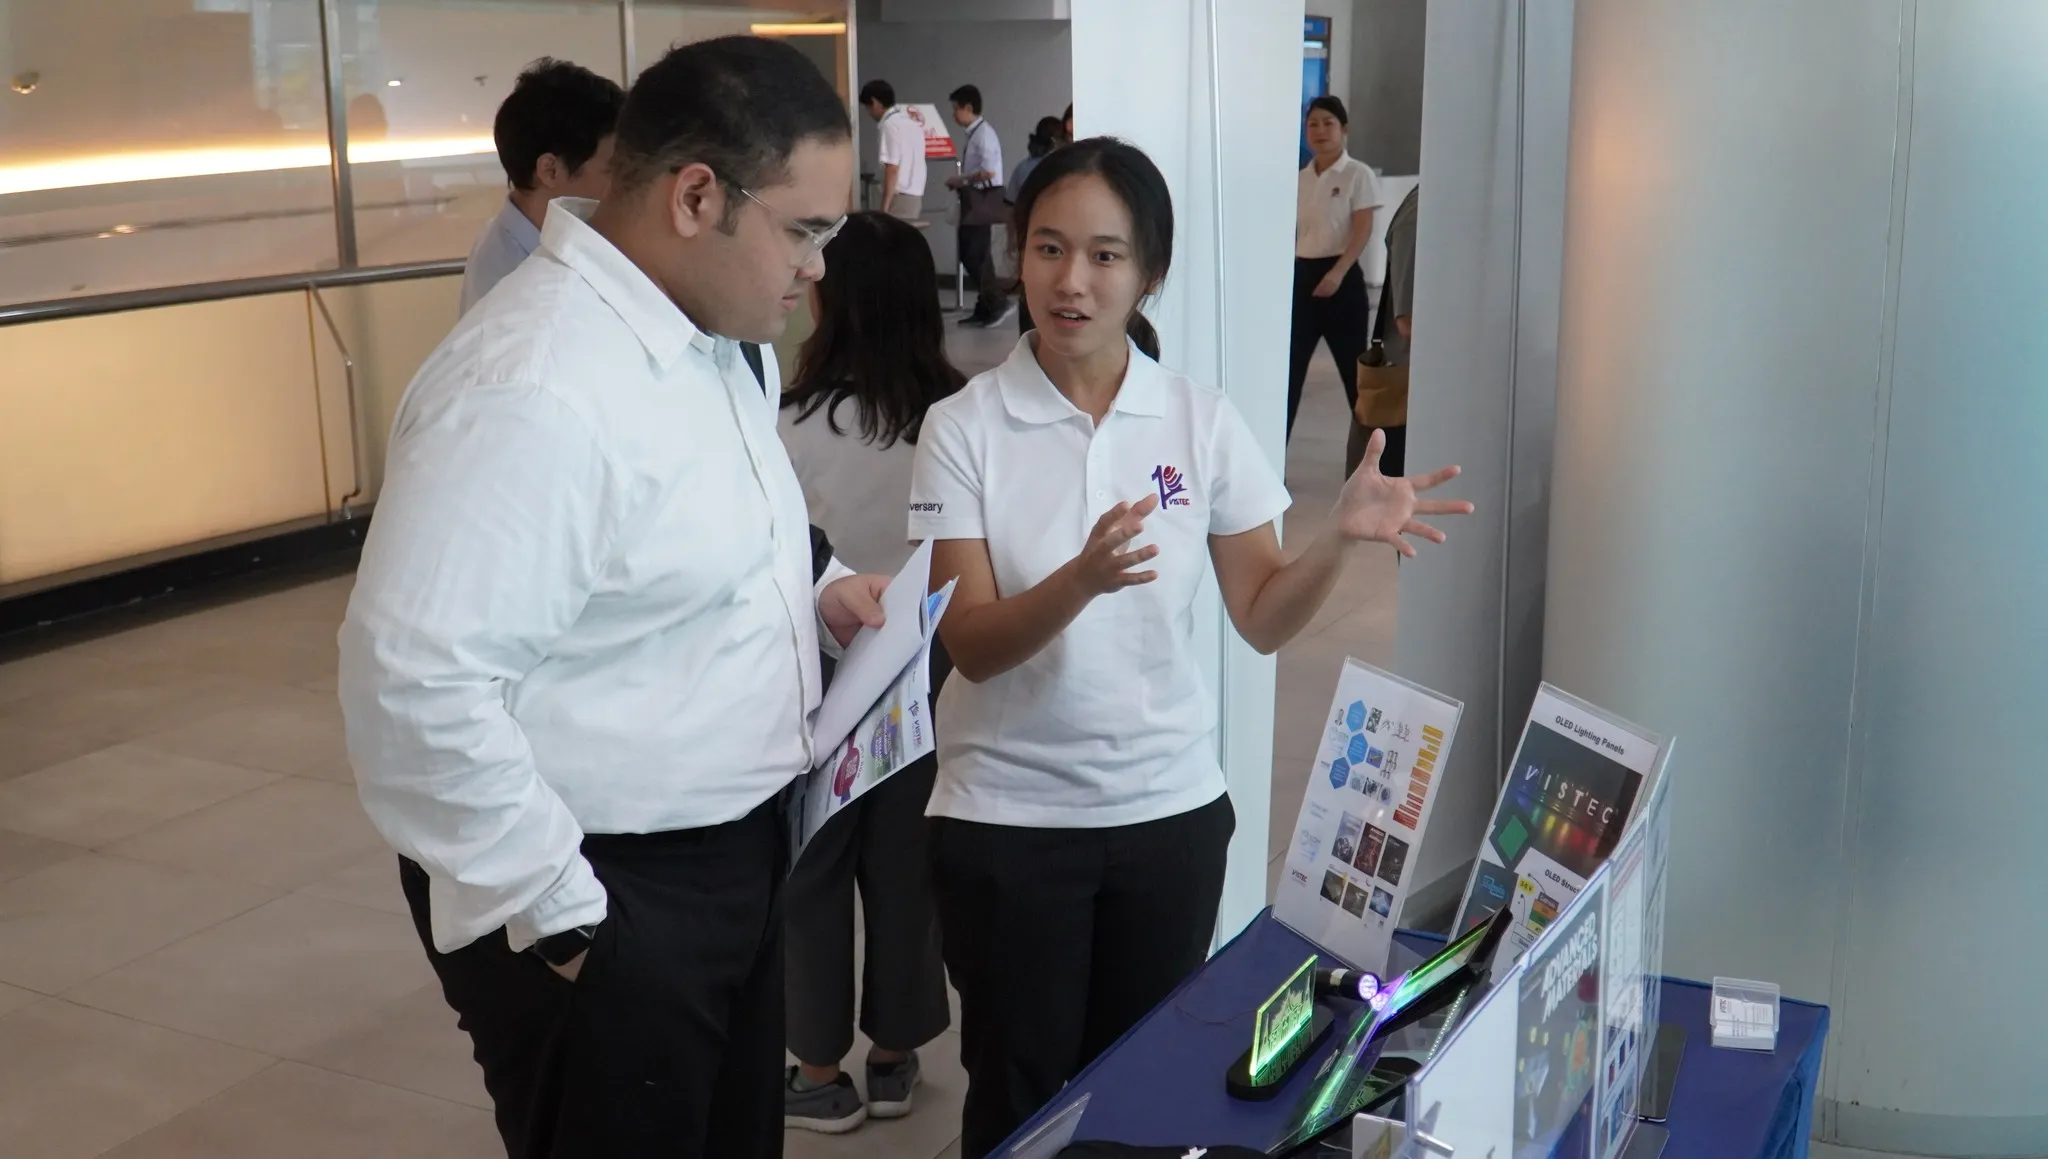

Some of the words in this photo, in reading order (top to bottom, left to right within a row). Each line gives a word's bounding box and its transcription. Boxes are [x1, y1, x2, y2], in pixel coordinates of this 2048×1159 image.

[1169, 498, 1190, 506] VISTEC
[1555, 715, 1574, 730] OLED
[1574, 724, 1601, 746] Lighting
[1601, 737, 1625, 756] Panels
[1524, 764, 1614, 824] VISTEC
[1544, 869, 1561, 884] OLED
[1540, 911, 1596, 999] ADVANCED
